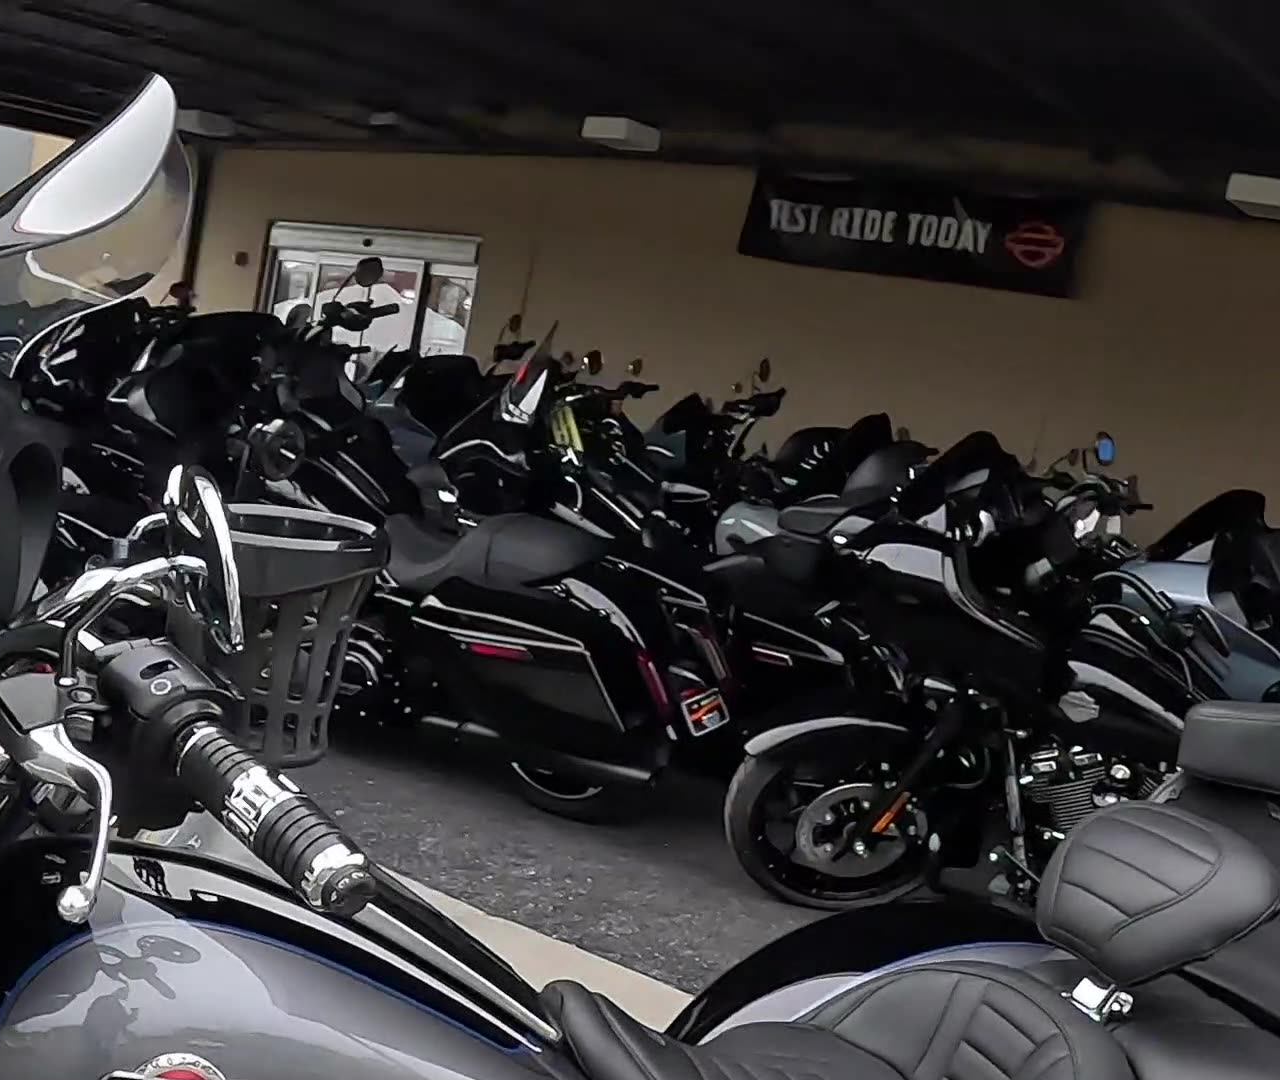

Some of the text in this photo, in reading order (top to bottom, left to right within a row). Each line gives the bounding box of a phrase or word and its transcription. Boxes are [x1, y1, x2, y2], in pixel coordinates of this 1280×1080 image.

[769, 199, 992, 254] TEST RIDE TODAY
